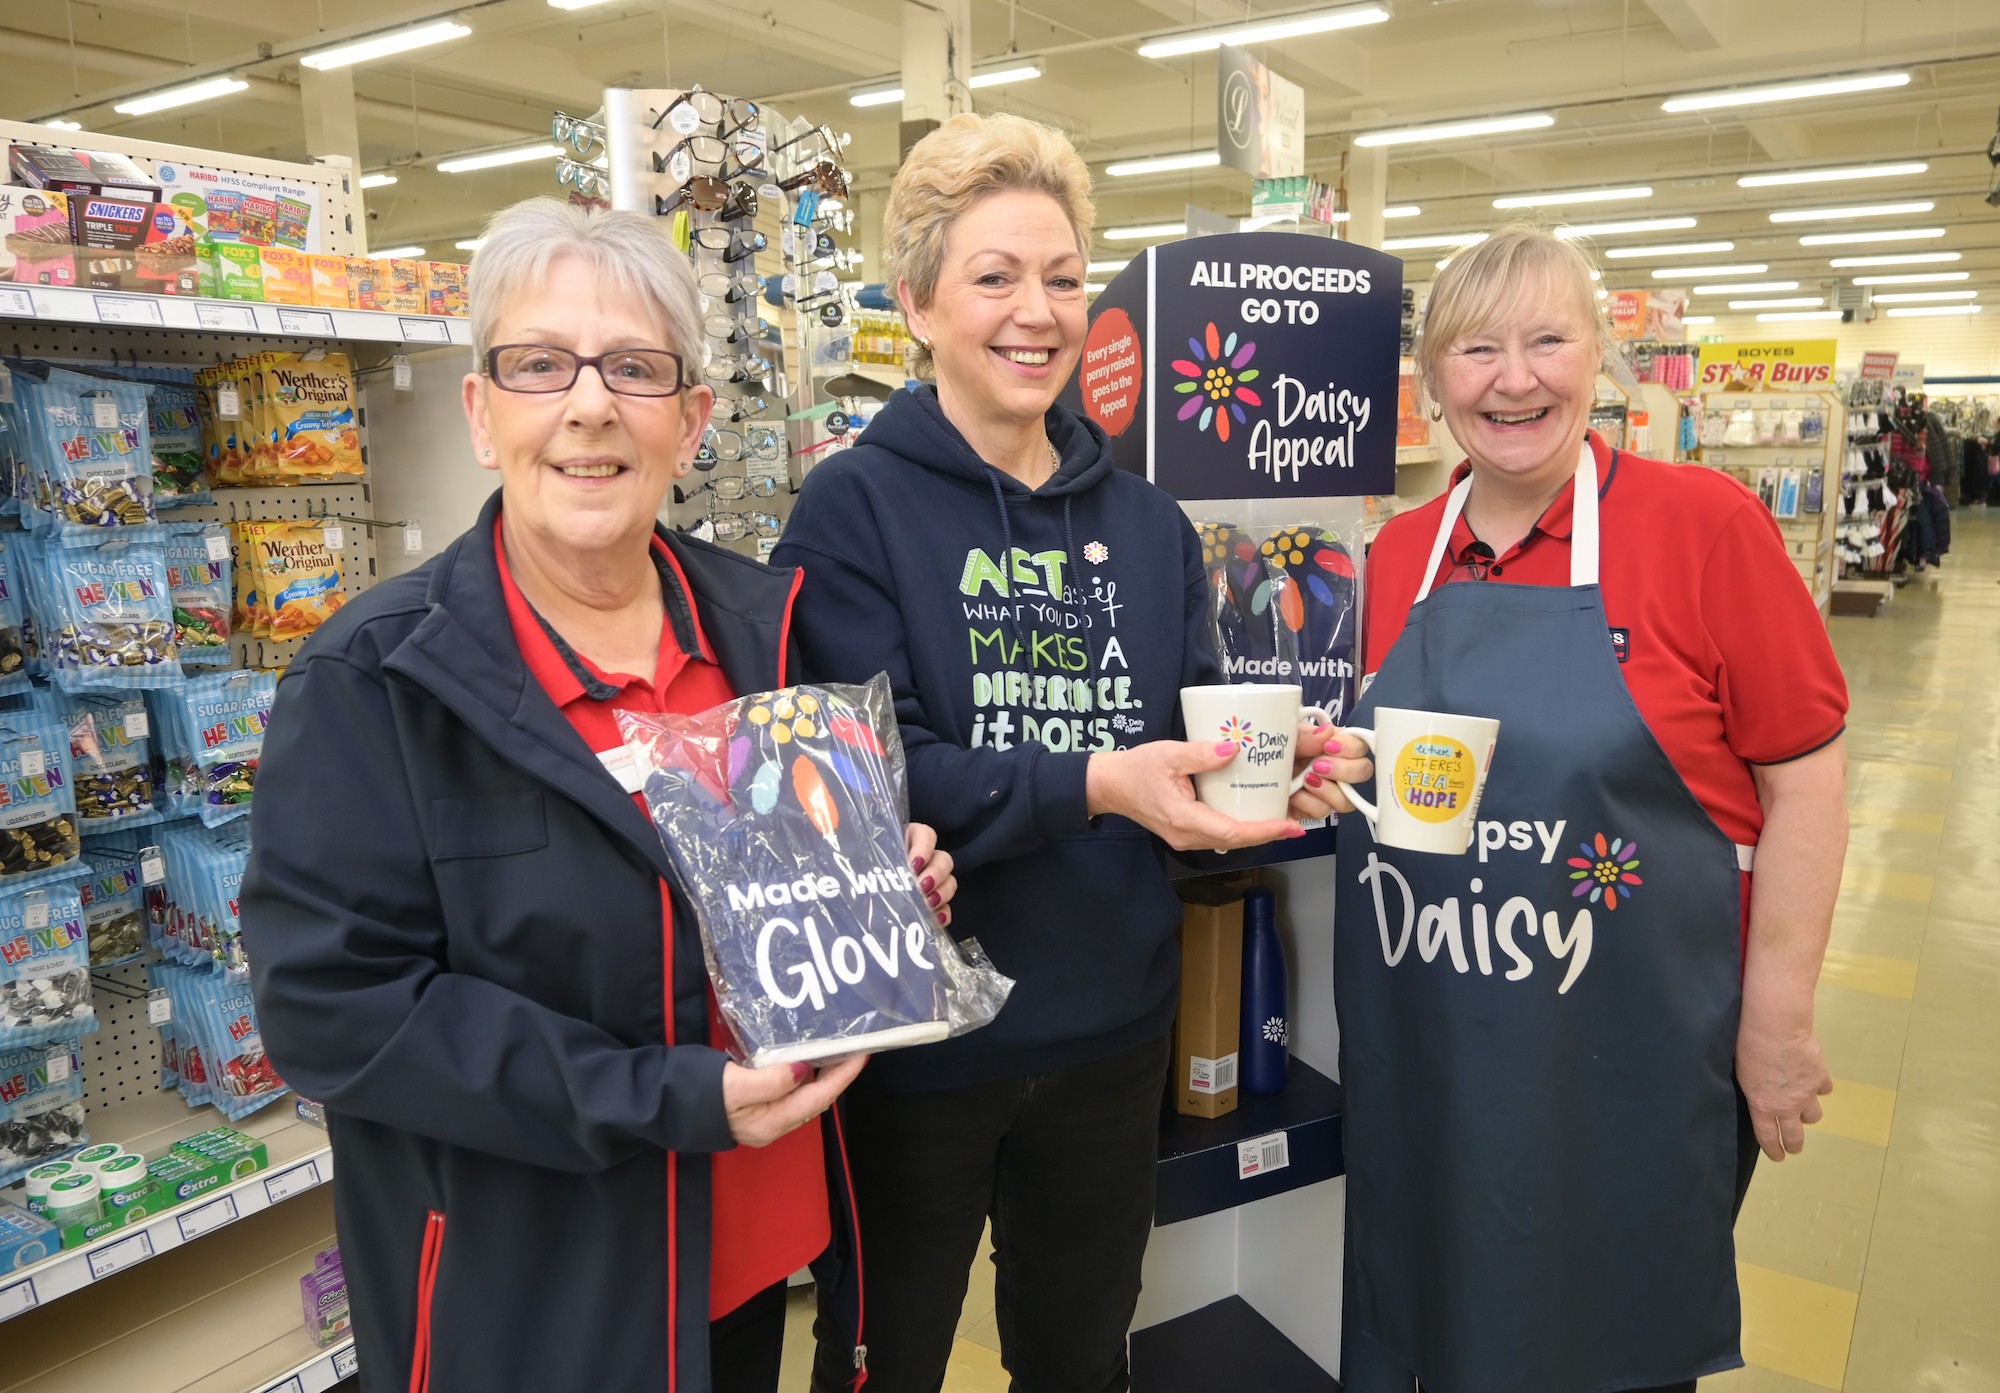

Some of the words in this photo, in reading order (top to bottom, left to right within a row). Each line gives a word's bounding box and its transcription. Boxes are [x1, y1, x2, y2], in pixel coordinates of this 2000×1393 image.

[189, 171, 218, 183] HARIBO
[221, 176, 240, 186] HFSS
[242, 180, 282, 194] Compliant
[283, 186, 306, 197] Range
[51, 194, 66, 209] NEW
[208, 195, 239, 205] HARIBO
[244, 201, 273, 213] HARIBO
[278, 201, 308, 215] HARIBO
[88, 202, 143, 221] SNICKERS
[178, 209, 190, 221] NEW
[85, 221, 114, 232] TRIPLE
[223, 246, 256, 258] FOX'S
[263, 251, 294, 262] FOX'S
[315, 259, 343, 270] FOX'S
[1190, 261, 1236, 288] ALL
[1240, 264, 1371, 295] PROCEEDS
[1241, 298, 1282, 325] GO
[1285, 300, 1320, 325] TO
[1613, 308, 1637, 316] VALUE
[262, 354, 276, 363] £1
[1087, 345, 1108, 364] Every
[1108, 335, 1132, 355] single
[1738, 347, 1795, 358] BOYES
[236, 361, 249, 371] £1
[248, 355, 261, 366] £1
[1086, 364, 1111, 387] penny
[1110, 351, 1136, 373] raised
[271, 370, 348, 389] Werther's
[1771, 362, 1831, 385] Buys
[166, 392, 196, 404] FREE
[295, 386, 348, 405] Original
[1092, 383, 1111, 403] goes
[1110, 380, 1119, 392] to
[1119, 375, 1133, 389] the
[1100, 394, 1128, 418] Appeal
[1271, 373, 1371, 434] Daisy
[296, 421, 321, 430] Creamy
[61, 428, 140, 463] HEAVEN
[1247, 419, 1355, 483] Appeal
[254, 526, 266, 536] £1
[163, 547, 191, 559] UGAR
[261, 540, 324, 558] Werther
[69, 562, 115, 576] SUGAR
[119, 563, 153, 576] FREE
[284, 554, 335, 572] Original
[959, 547, 1068, 602] ACT
[76, 578, 155, 607] HEAVEN
[283, 588, 307, 600] Creamy
[1088, 576, 1124, 628] if
[963, 602, 1024, 622] WHAT
[1030, 602, 1062, 627] YOU
[969, 627, 1088, 672] MAKES
[1100, 635, 1129, 671] A
[1224, 655, 1293, 677] Made
[1300, 655, 1354, 679] with
[198, 702, 239, 718] SUGAR
[241, 697, 272, 711] FREE
[202, 709, 271, 749] HEAVEN
[971, 710, 1015, 753] it
[1125, 725, 1144, 735] Appeal
[1128, 718, 1145, 728] Daisy
[1258, 732, 1289, 750] Daisy
[1247, 744, 1285, 767] Appeal
[1411, 757, 1462, 773] THERE'S
[1406, 771, 1448, 790] TEA
[1409, 787, 1457, 809] HOPE
[6, 815, 30, 826] LIQUORICE
[30, 810, 47, 821] TOFFEE
[727, 872, 841, 912] Made
[850, 866, 917, 900] with
[1358, 851, 1594, 996] Daisy
[0, 918, 83, 966] HEAVEN
[27, 964, 46, 974] THROAT
[50, 960, 66, 970] CHEST
[755, 915, 935, 1011] Glove
[23, 1101, 41, 1112] THROAT
[179, 1174, 218, 1197] extra
[272, 1189, 287, 1200] £1.99
[113, 1187, 149, 1206] extra
[86, 1221, 113, 1237] extra
[96, 1262, 114, 1275] £2.75
[337, 1356, 358, 1373] £1.49
